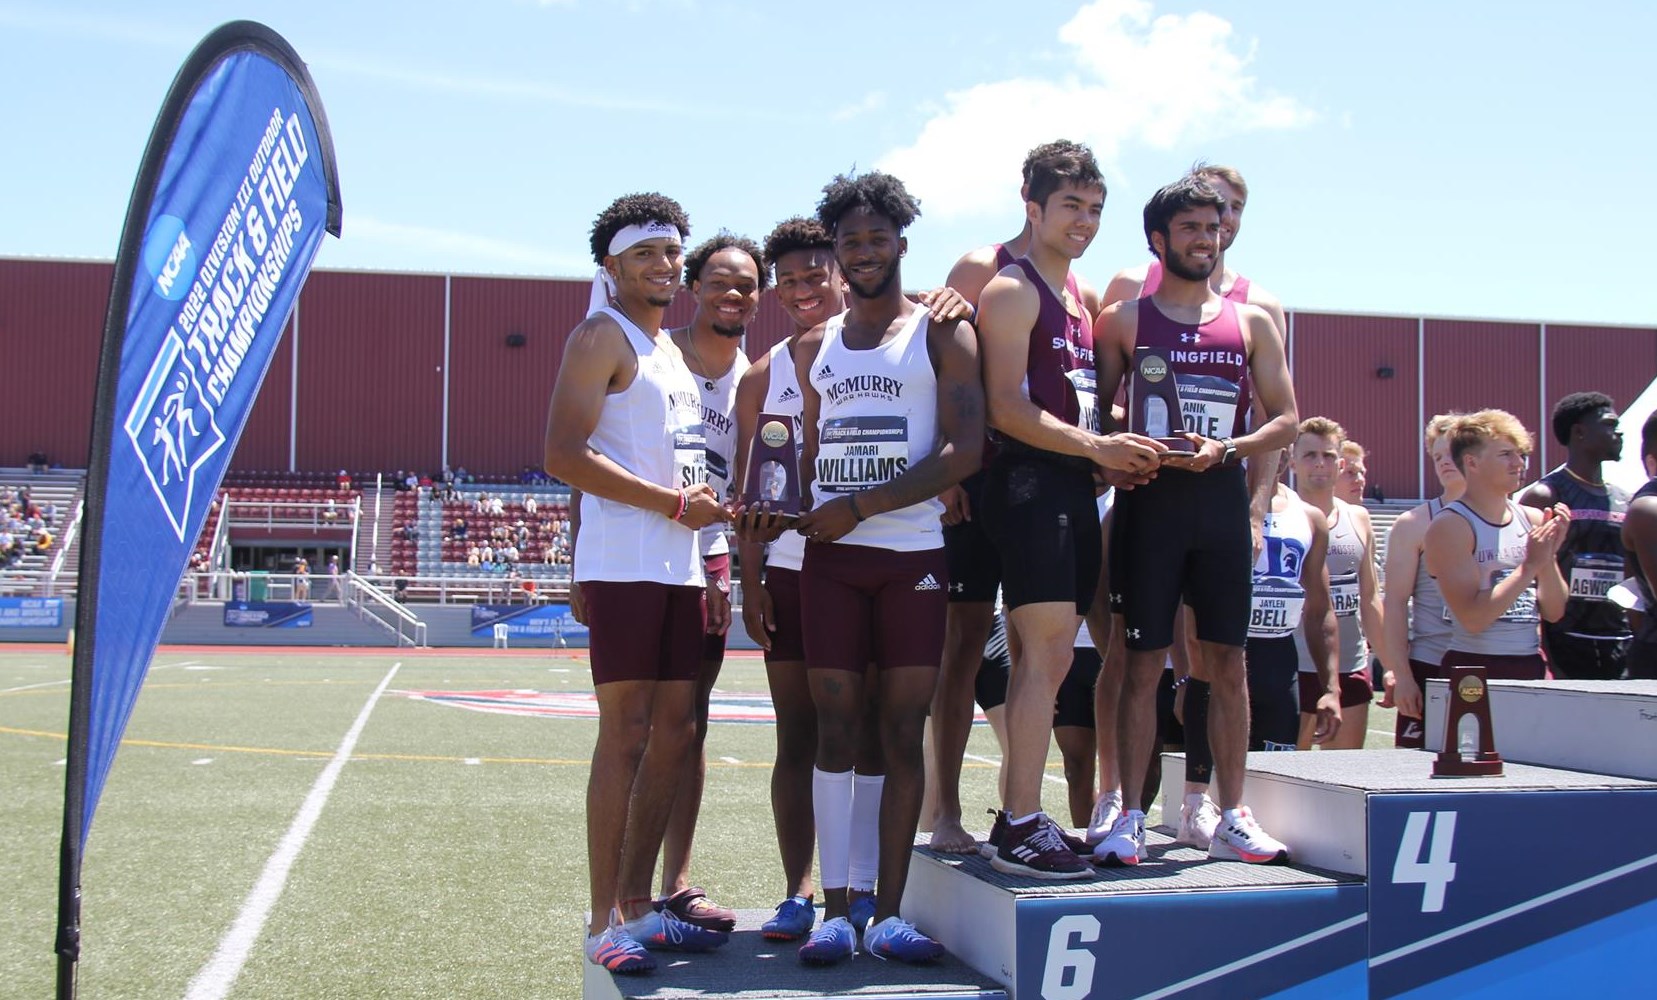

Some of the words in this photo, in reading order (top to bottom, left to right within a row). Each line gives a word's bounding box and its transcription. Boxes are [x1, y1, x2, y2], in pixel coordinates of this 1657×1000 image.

[178, 281, 208, 334] 2022
[199, 202, 242, 289] DIVISION
[236, 175, 254, 212] III
[249, 107, 285, 185] OUTDOOR
[187, 230, 257, 374] TRACK
[246, 205, 268, 256] &
[258, 112, 308, 229] FIELD
[157, 231, 191, 296] NCAA
[207, 199, 303, 406] CHAMPIONSHIPS
[1170, 350, 1243, 366] INGFIELD
[1143, 367, 1167, 375] NCAA
[836, 395, 855, 406] WAR
[858, 392, 893, 402] HAWKS
[1183, 402, 1206, 413] ANIK
[844, 445, 879, 456] JAMARI
[818, 457, 908, 482] WILLIAMS
[1259, 600, 1285, 609] JAYLEN
[1251, 609, 1287, 627] BELL
[1462, 687, 1484, 696] NCAA
[1392, 811, 1457, 912] 4
[1041, 914, 1101, 1000] 6
